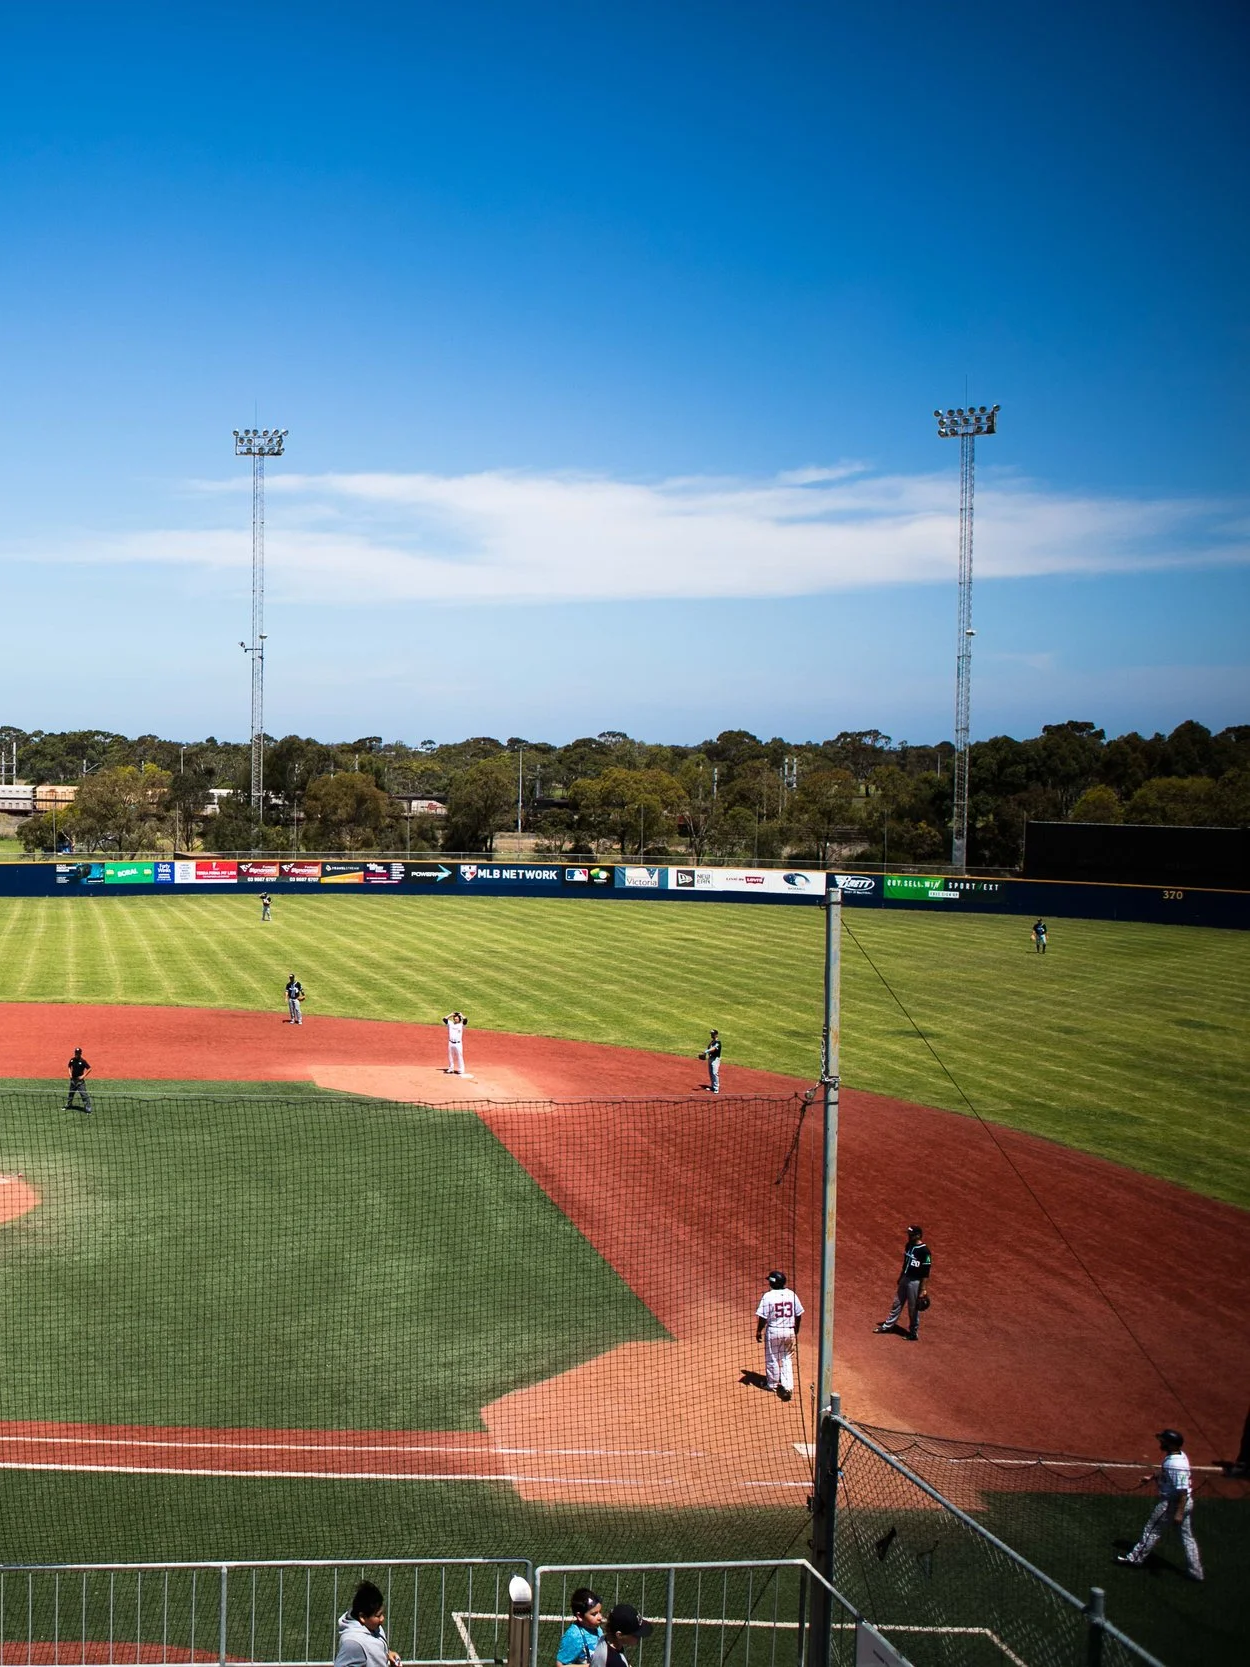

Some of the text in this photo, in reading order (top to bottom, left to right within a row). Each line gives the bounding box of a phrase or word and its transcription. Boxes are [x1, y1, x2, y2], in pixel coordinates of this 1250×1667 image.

[478, 869, 558, 880] MLB NETWORK
[627, 878, 658, 886] Victoria
[1162, 890, 1183, 900] 370
[910, 1258, 920, 1268] 20
[774, 1302, 793, 1318] 53
